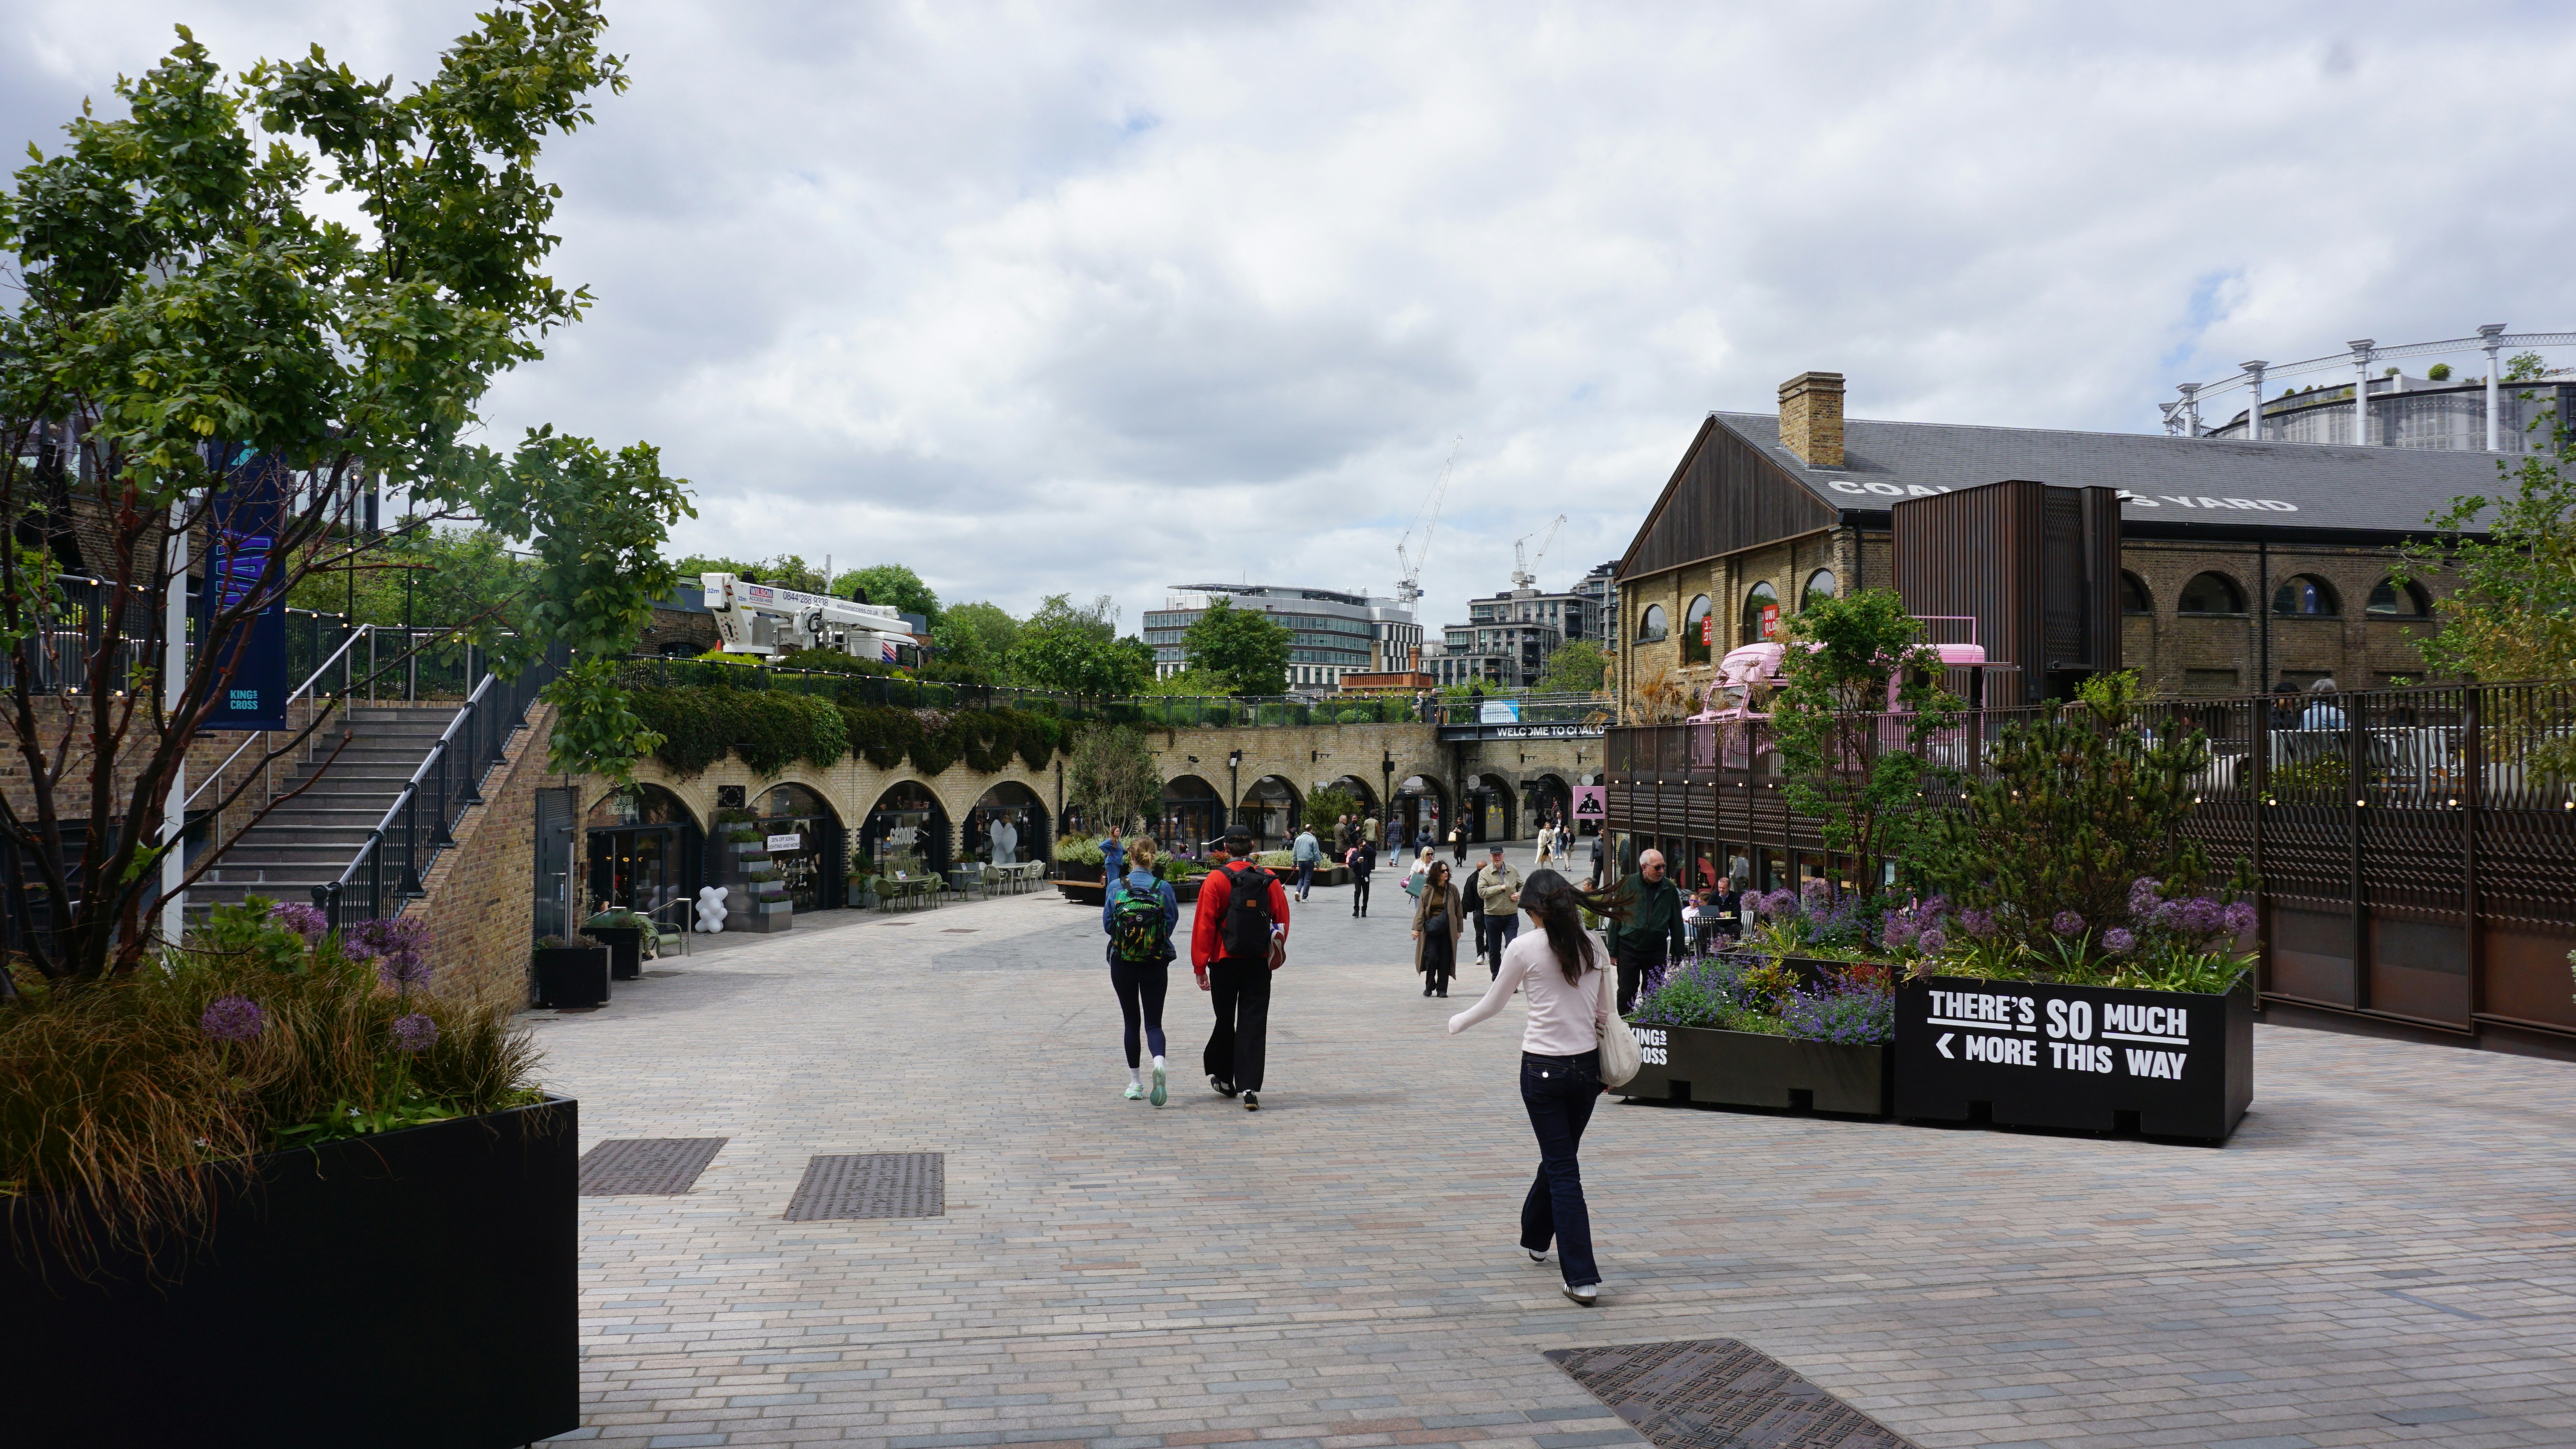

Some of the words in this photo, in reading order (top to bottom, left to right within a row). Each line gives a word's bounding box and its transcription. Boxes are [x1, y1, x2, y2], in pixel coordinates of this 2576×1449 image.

[2158, 495, 2299, 511] YARD
[750, 586, 772, 598] WILSON
[783, 591, 799, 602] 0844
[800, 594, 811, 604] 288
[837, 603, 879, 616] wilsonaccess.co.uk
[1765, 609, 1775, 621] UNI
[1765, 621, 1776, 634] QLO
[230, 700, 258, 709] CROSS
[1497, 726, 1549, 737] WELCOME
[1551, 726, 1565, 735] TO
[1567, 725, 1595, 735] COAL
[730, 786, 741, 797] DIXON
[890, 826, 917, 846] GROOVE
[1929, 990, 2035, 1024] THERE'S
[2046, 999, 2092, 1040] SO
[2104, 1003, 2187, 1036] MUCH
[1641, 1046, 1667, 1065] OSS
[1965, 1034, 2037, 1066] MORE
[2049, 1042, 2112, 1073] THIS
[2126, 1048, 2187, 1080] WAY
